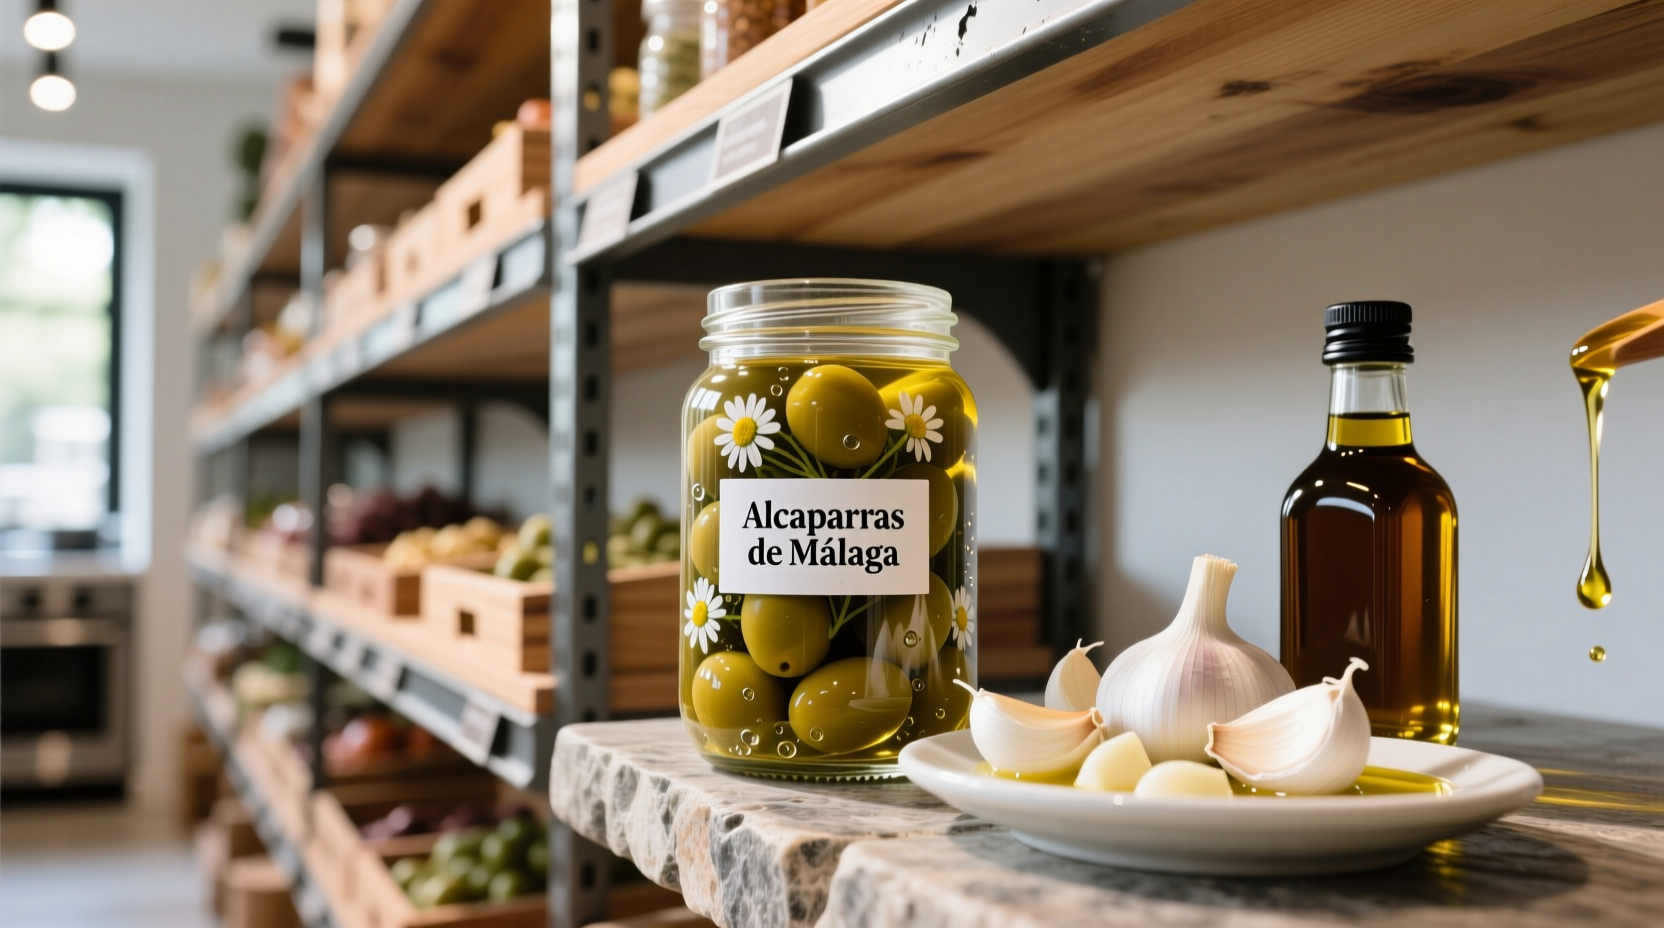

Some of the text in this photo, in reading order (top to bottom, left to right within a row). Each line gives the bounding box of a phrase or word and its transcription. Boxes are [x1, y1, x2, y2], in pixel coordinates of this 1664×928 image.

[742, 500, 904, 536] Alcaparras
[748, 537, 900, 574] de Málaga
